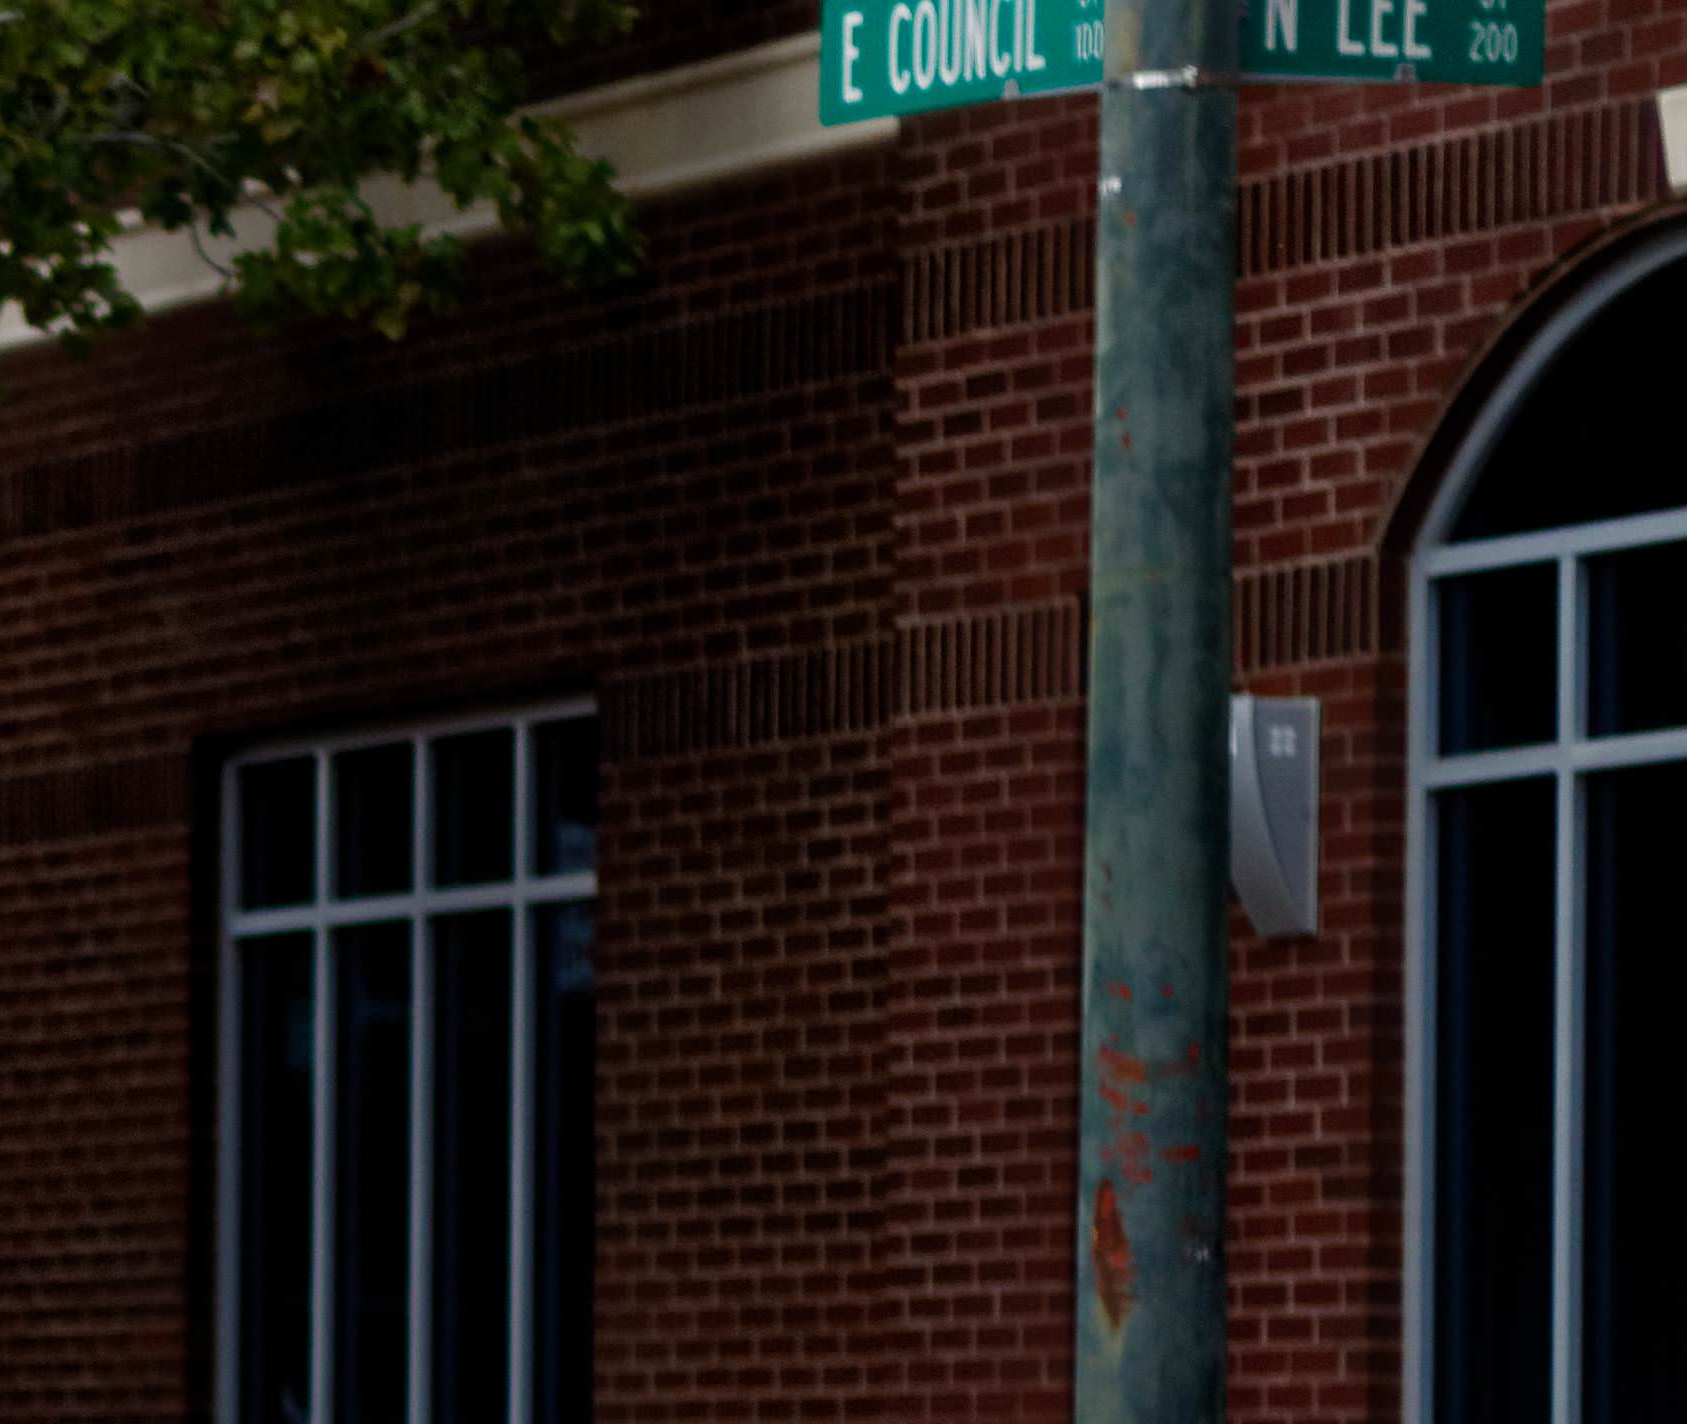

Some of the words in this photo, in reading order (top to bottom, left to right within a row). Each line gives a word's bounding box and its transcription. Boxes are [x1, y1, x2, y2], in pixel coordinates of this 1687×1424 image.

[841, 10, 864, 103] E
[889, 0, 1047, 94] COUNCIL
[1076, 20, 1104, 60] 100
[1264, 0, 1298, 52] N
[1336, 0, 1432, 59] LEE
[1469, 22, 1518, 63] 200
